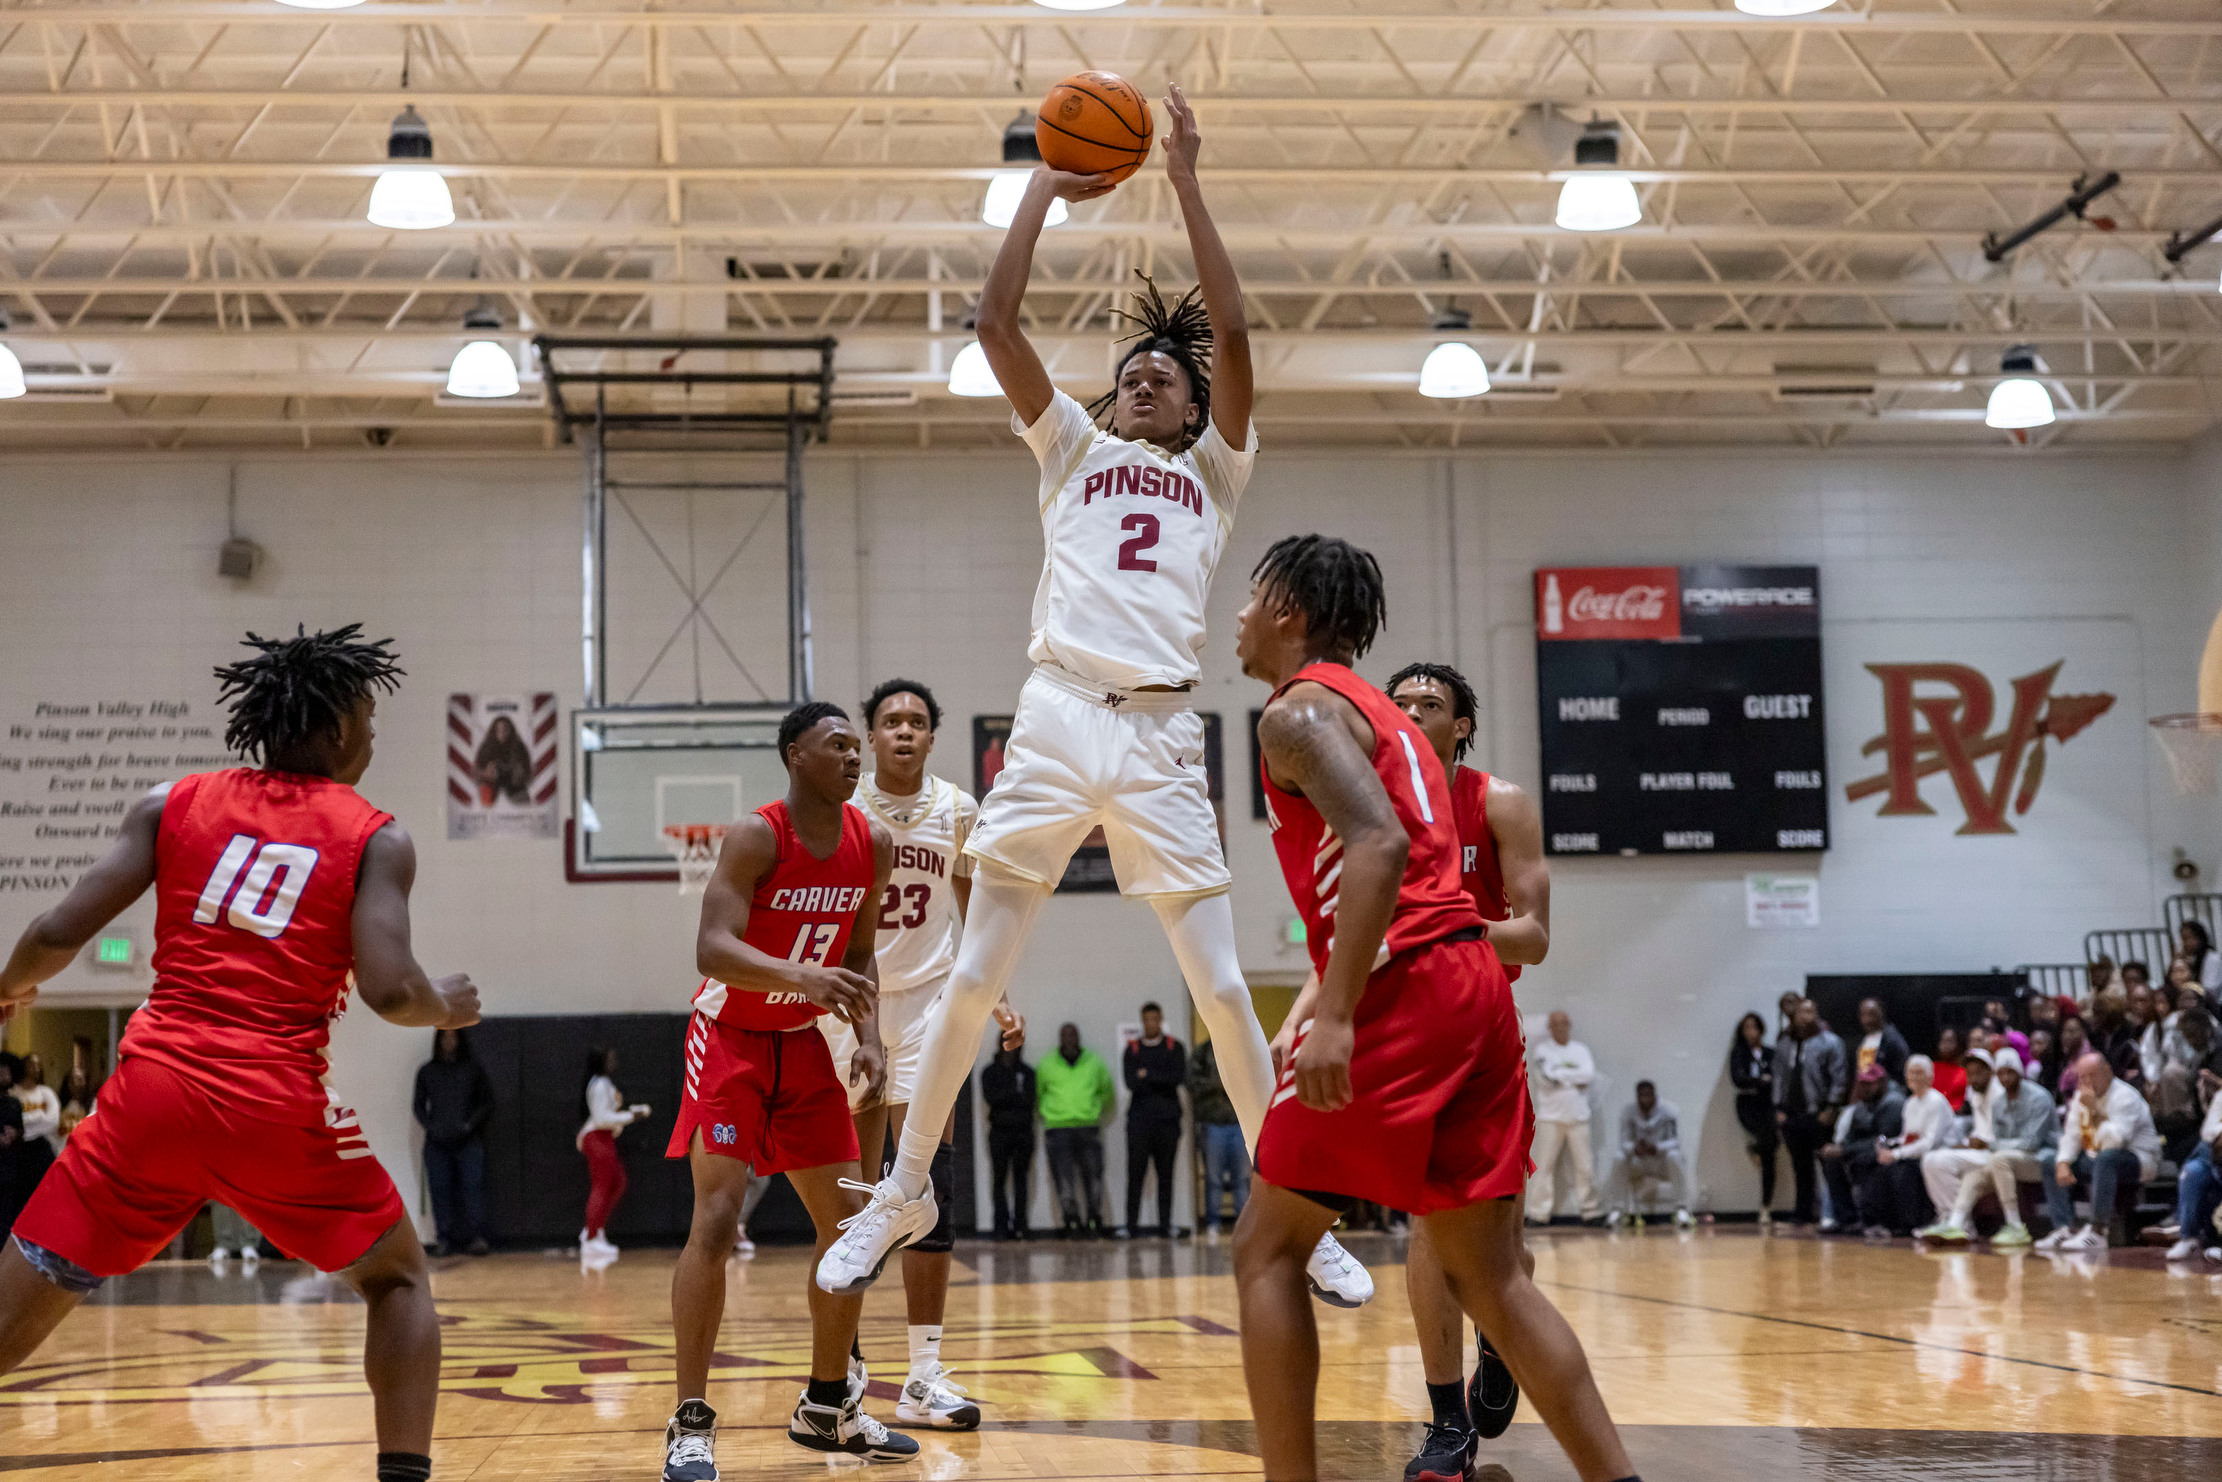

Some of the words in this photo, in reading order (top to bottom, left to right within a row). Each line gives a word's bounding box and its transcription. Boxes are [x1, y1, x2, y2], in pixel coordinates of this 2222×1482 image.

[1084, 465, 1203, 518] PINSON
[1118, 513, 1160, 573] 2
[1683, 588, 1813, 606] POWERADE
[35, 702, 91, 718] Pinson
[97, 701, 145, 720] Valley
[149, 700, 190, 718] High
[1559, 696, 1620, 721] HOME
[1657, 707, 1711, 726] PERIOD
[1743, 694, 1812, 719] GUEST
[10, 724, 33, 740] We
[1397, 729, 1434, 825] 1
[1551, 773, 1597, 792] FOULS
[1639, 772, 1695, 791] PLAYER
[1697, 771, 1735, 790] FOUL
[1774, 770, 1822, 789] FOULS
[1552, 833, 1599, 850] SCORE
[1663, 831, 1714, 849] MATCH
[1777, 830, 1824, 848] SCORE
[893, 845, 946, 879] SON
[192, 832, 320, 940] 10
[769, 885, 867, 914] CARVER
[877, 883, 932, 930] 23
[787, 922, 841, 968] 13
